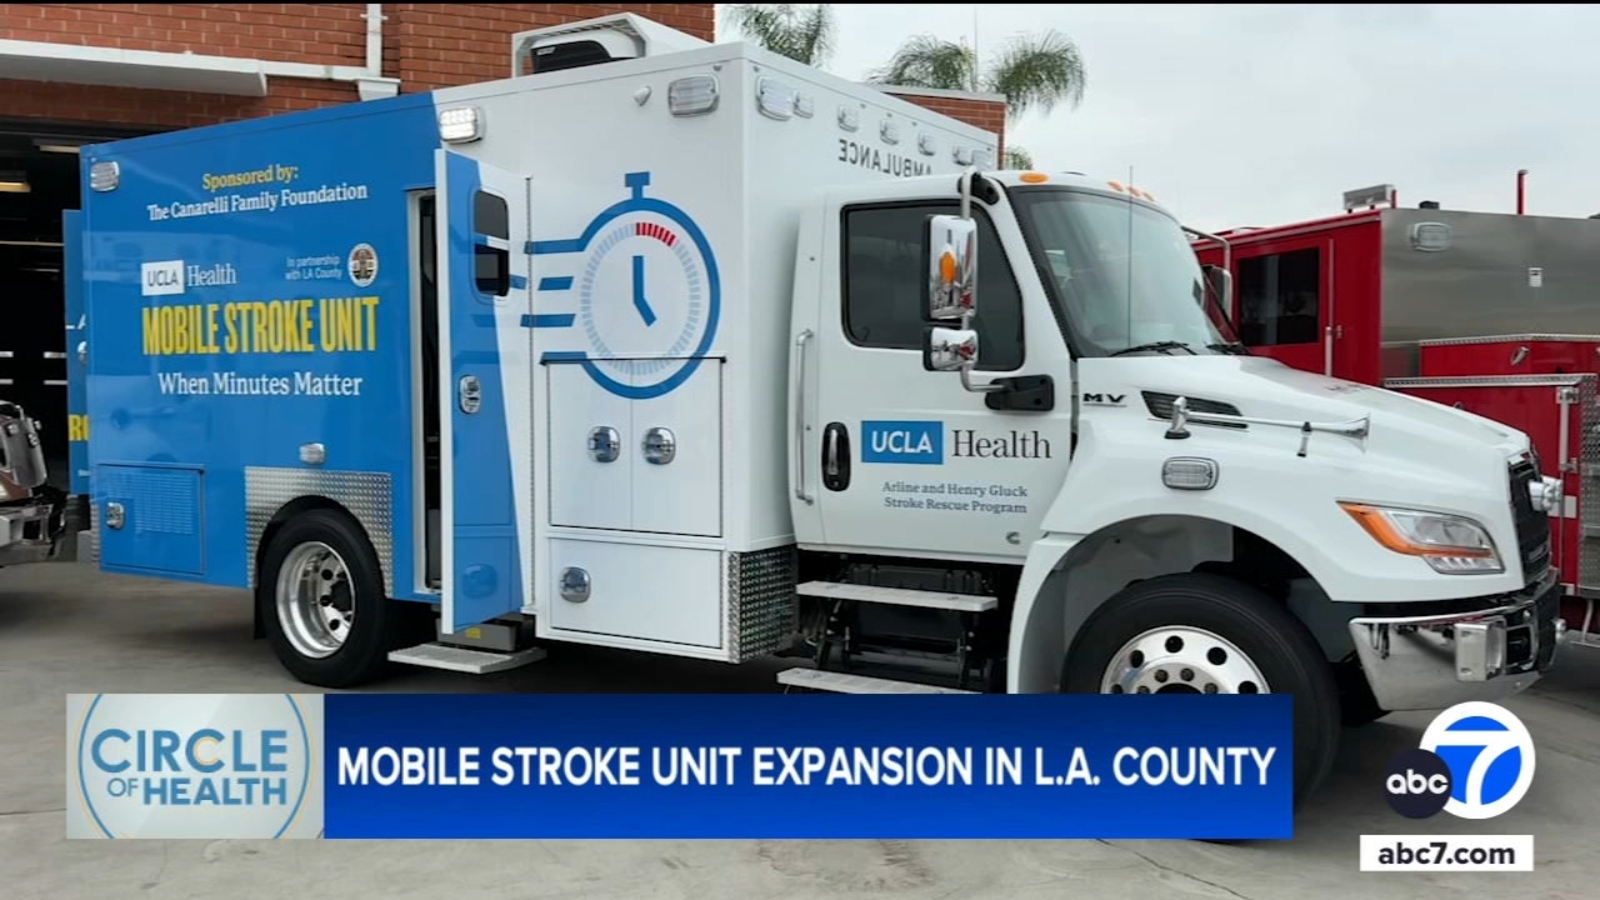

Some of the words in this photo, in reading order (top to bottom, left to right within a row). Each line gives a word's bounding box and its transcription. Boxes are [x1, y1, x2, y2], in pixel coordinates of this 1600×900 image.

[202, 164, 274, 192] Sponsored
[276, 164, 299, 183] by:
[147, 203, 171, 221] The
[171, 197, 229, 217] Canarelli
[231, 192, 278, 212] Family
[281, 182, 368, 207] Foundation
[147, 267, 180, 288] UCLA
[187, 264, 237, 287] Health
[142, 304, 221, 355] MOBILE
[223, 300, 314, 354] STROKE
[319, 297, 379, 352] UNIT
[158, 371, 209, 396] When
[214, 371, 290, 396] Minutes
[294, 372, 363, 396] Matter
[1083, 393, 1126, 403] MV
[871, 431, 933, 453] UCLA
[952, 430, 1052, 459] Health
[882, 482, 921, 493] Arline
[922, 484, 945, 494] and
[948, 484, 986, 498] Henry
[989, 484, 1028, 498] Gluck
[884, 497, 924, 509] Stroke
[926, 499, 969, 511] Rescue
[972, 501, 1027, 516] Program
